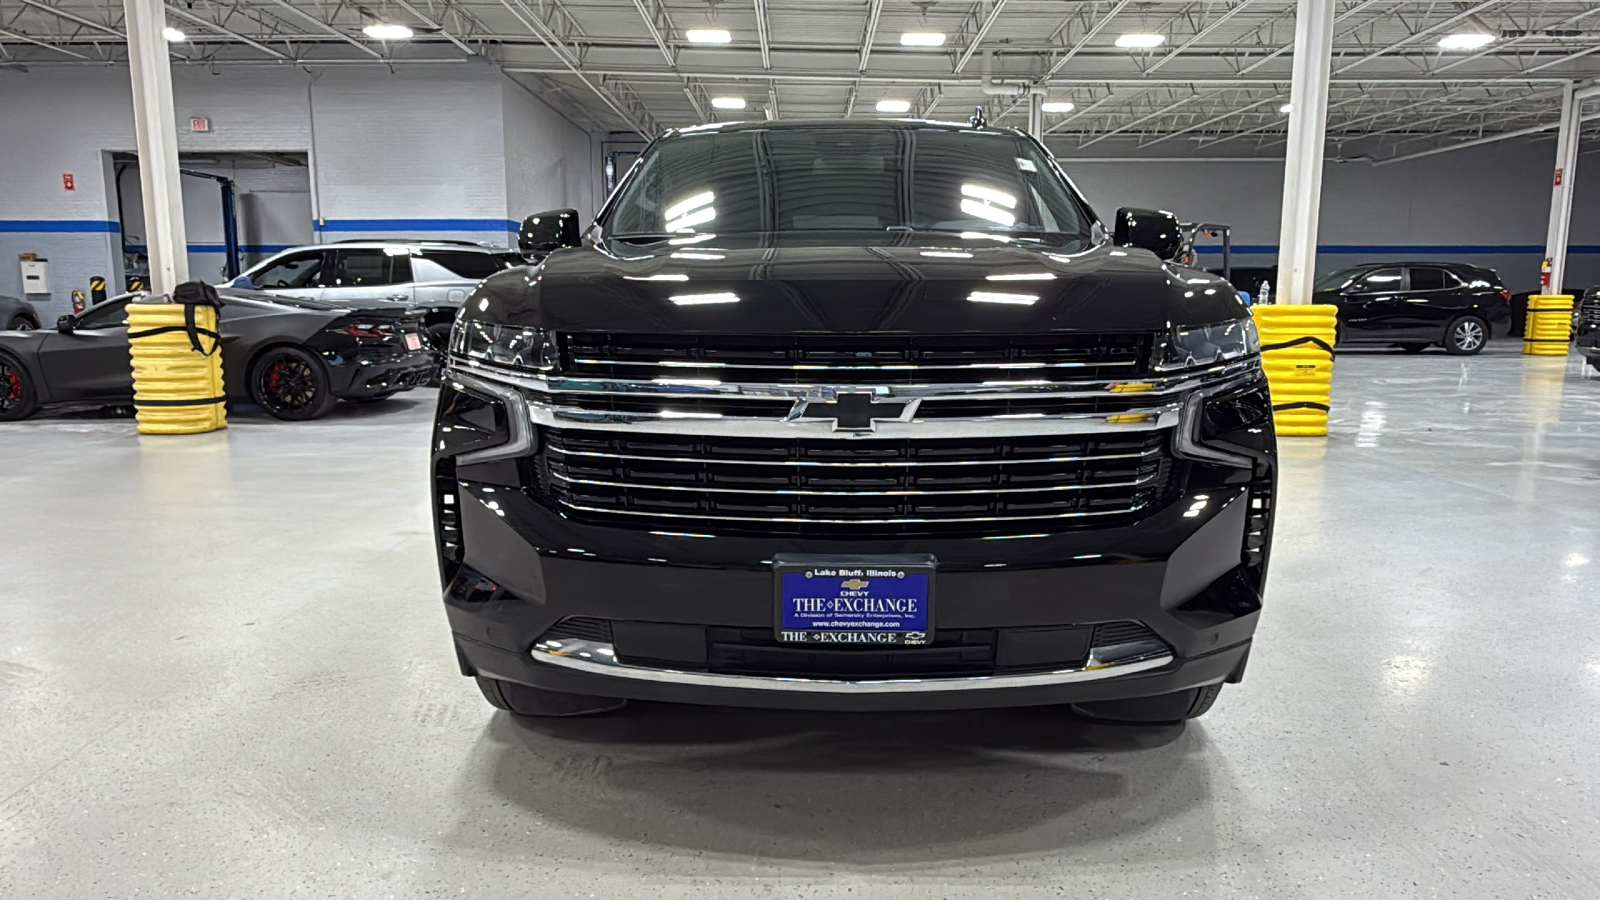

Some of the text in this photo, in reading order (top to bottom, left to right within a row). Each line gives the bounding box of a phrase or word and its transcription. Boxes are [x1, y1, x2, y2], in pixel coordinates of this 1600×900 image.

[839, 569, 864, 577] Bluff,
[793, 598, 917, 612] THE EXCHANGE
[781, 631, 897, 643] THE EXCHANGE
